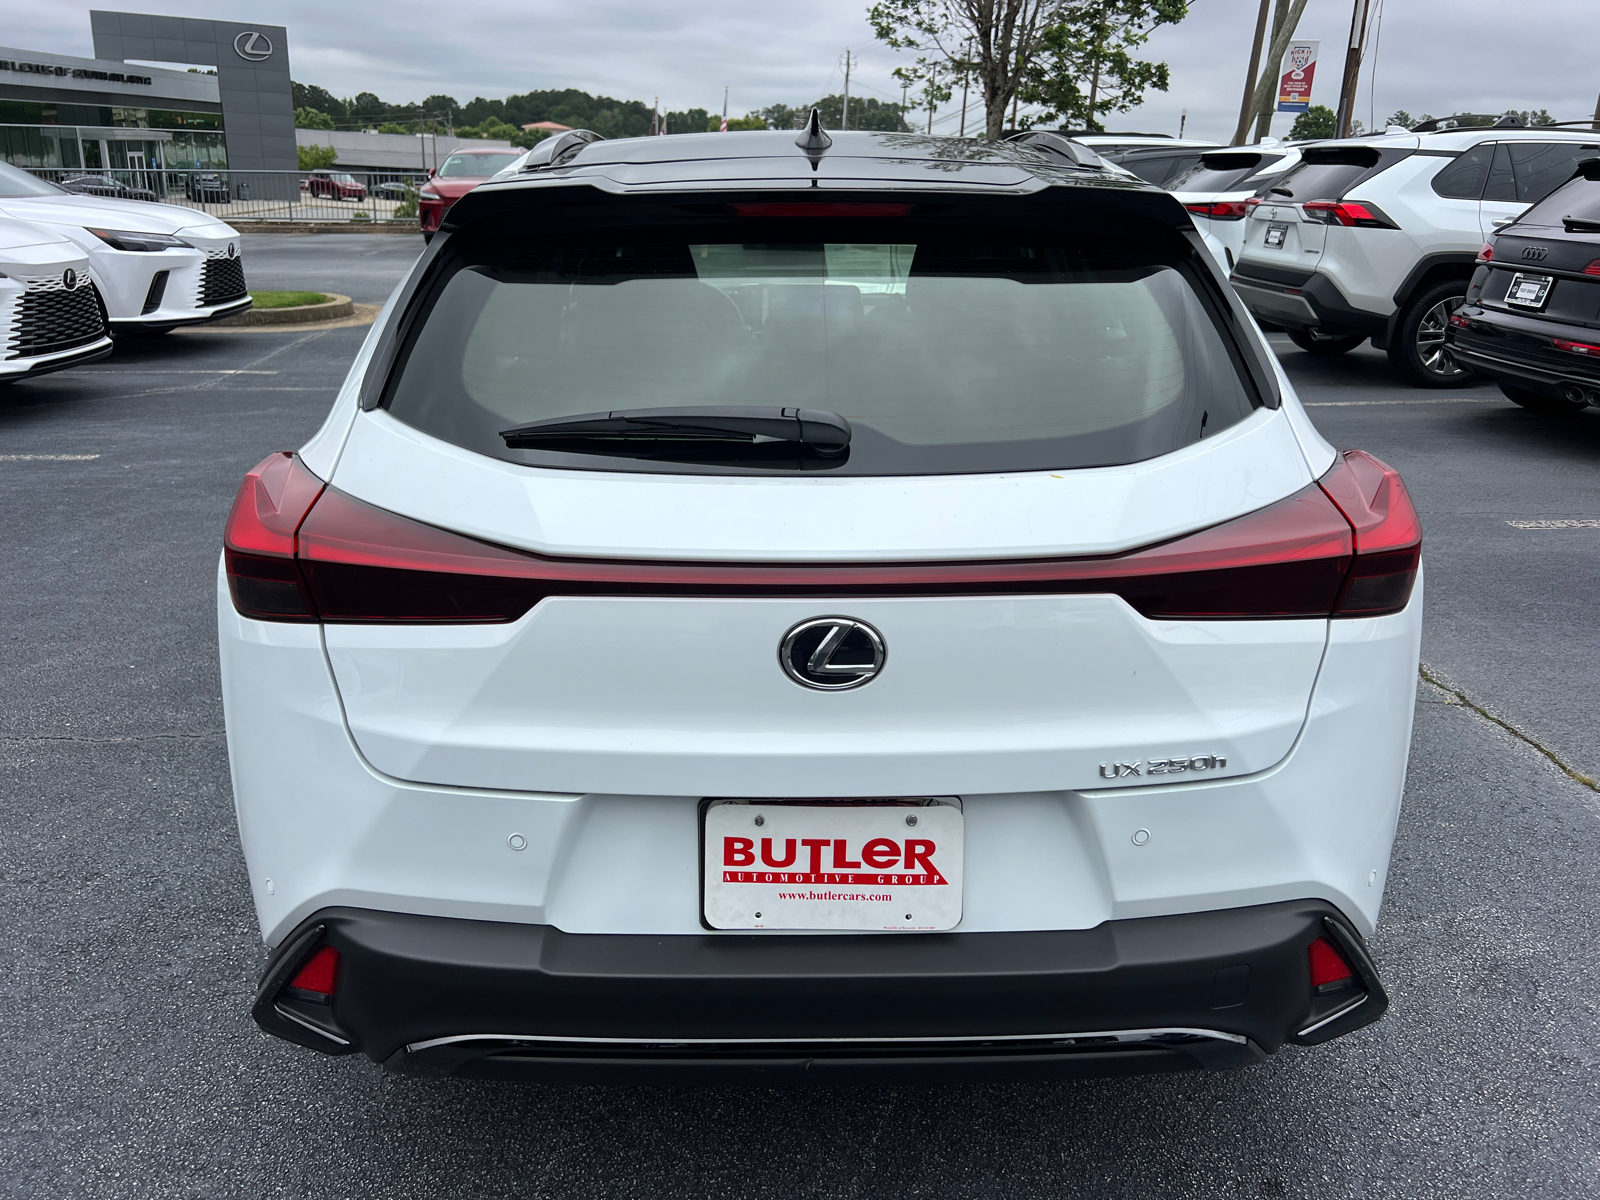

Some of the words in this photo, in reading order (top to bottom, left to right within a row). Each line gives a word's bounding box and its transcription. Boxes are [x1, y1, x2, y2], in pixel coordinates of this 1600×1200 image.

[10, 61, 54, 75] LEXUS
[55, 66, 71, 76] OF
[1099, 760, 1142, 779] UX
[1147, 753, 1227, 775] 250h
[724, 873, 854, 883] AUTOMOTIVE
[877, 874, 940, 884] GROUP
[778, 891, 892, 901] www.butlercars.com
